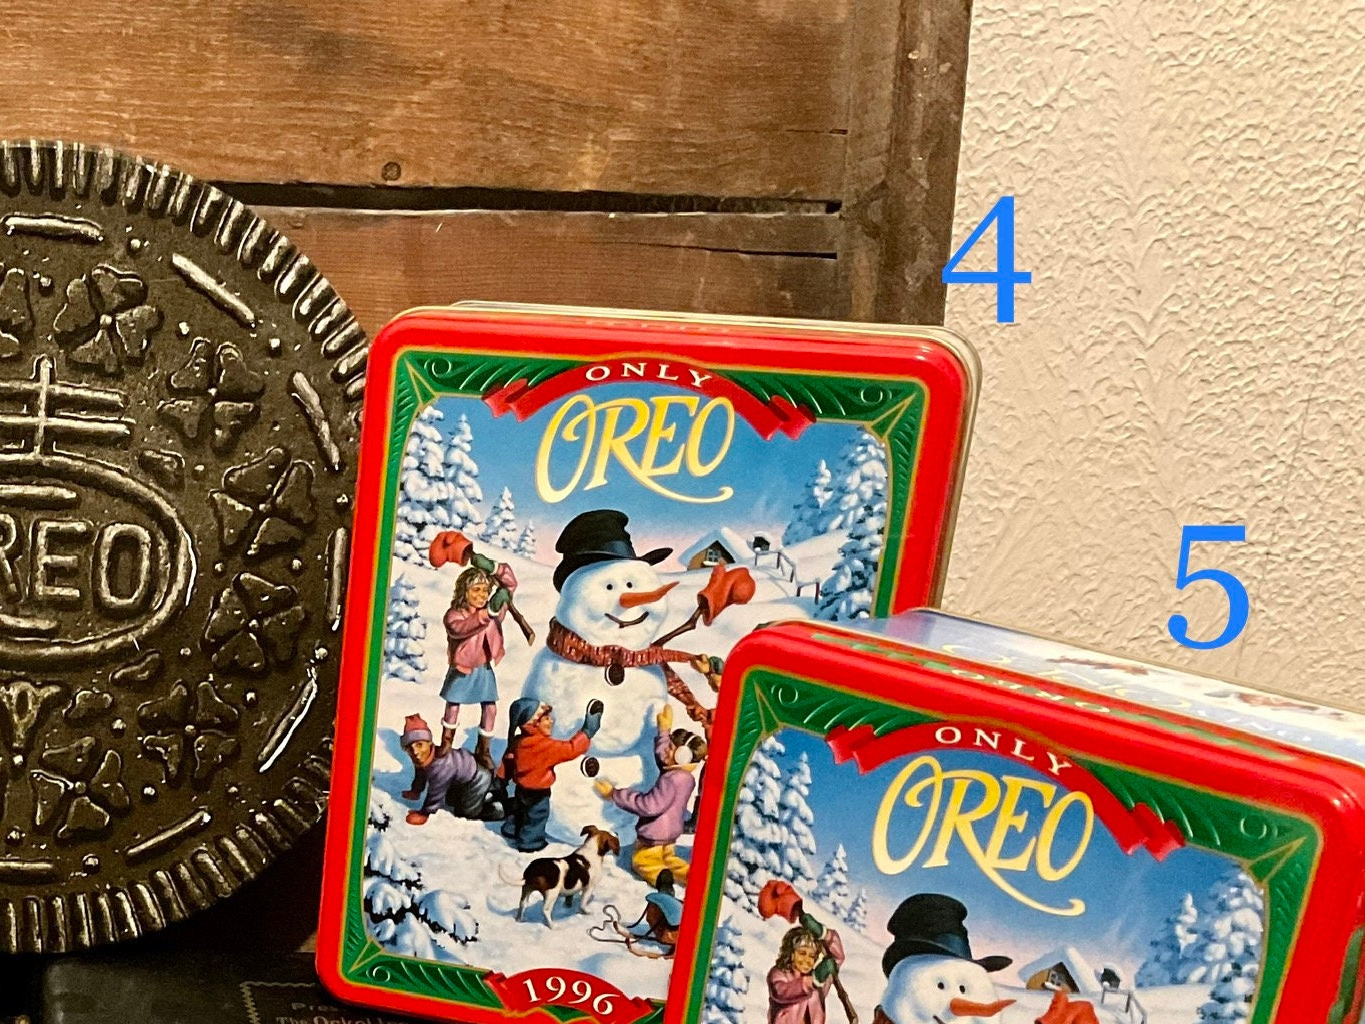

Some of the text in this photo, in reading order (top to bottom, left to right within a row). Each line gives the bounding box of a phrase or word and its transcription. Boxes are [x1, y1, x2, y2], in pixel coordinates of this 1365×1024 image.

[585, 361, 714, 389] ONLY
[536, 394, 735, 503] OREO
[935, 726, 1073, 777] ONLY
[871, 755, 1095, 917] OREO
[523, 976, 620, 1015] 1996
